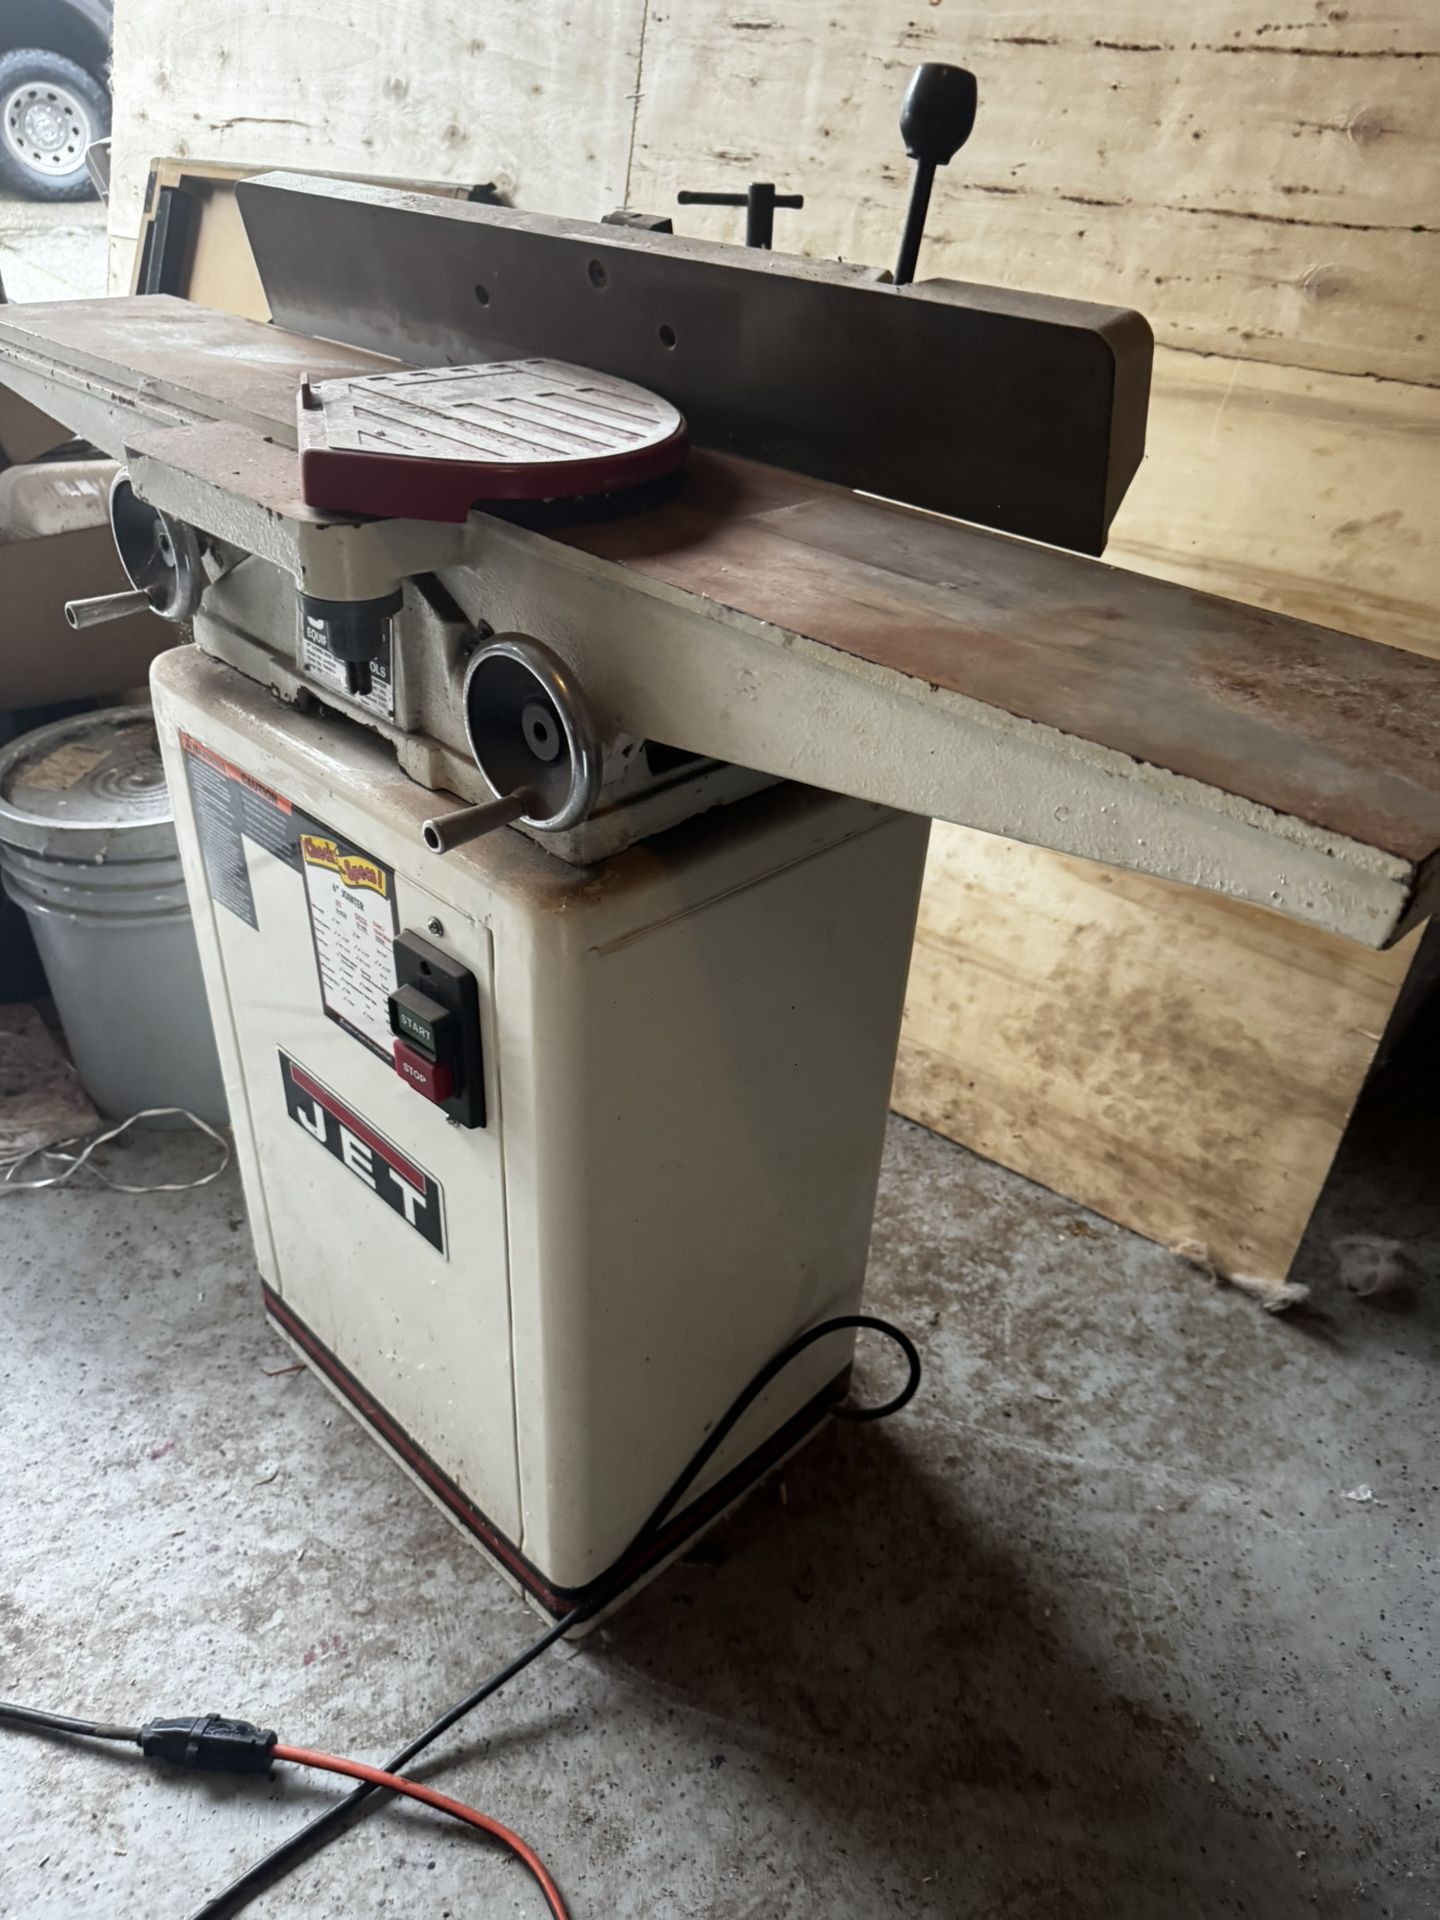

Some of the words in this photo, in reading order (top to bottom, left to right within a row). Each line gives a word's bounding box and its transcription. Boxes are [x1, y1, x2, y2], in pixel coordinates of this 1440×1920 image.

[241, 772, 278, 804] CAUTION
[400, 1013, 431, 1041] START
[402, 1061, 427, 1083] STOP
[297, 1100, 427, 1227] JET
